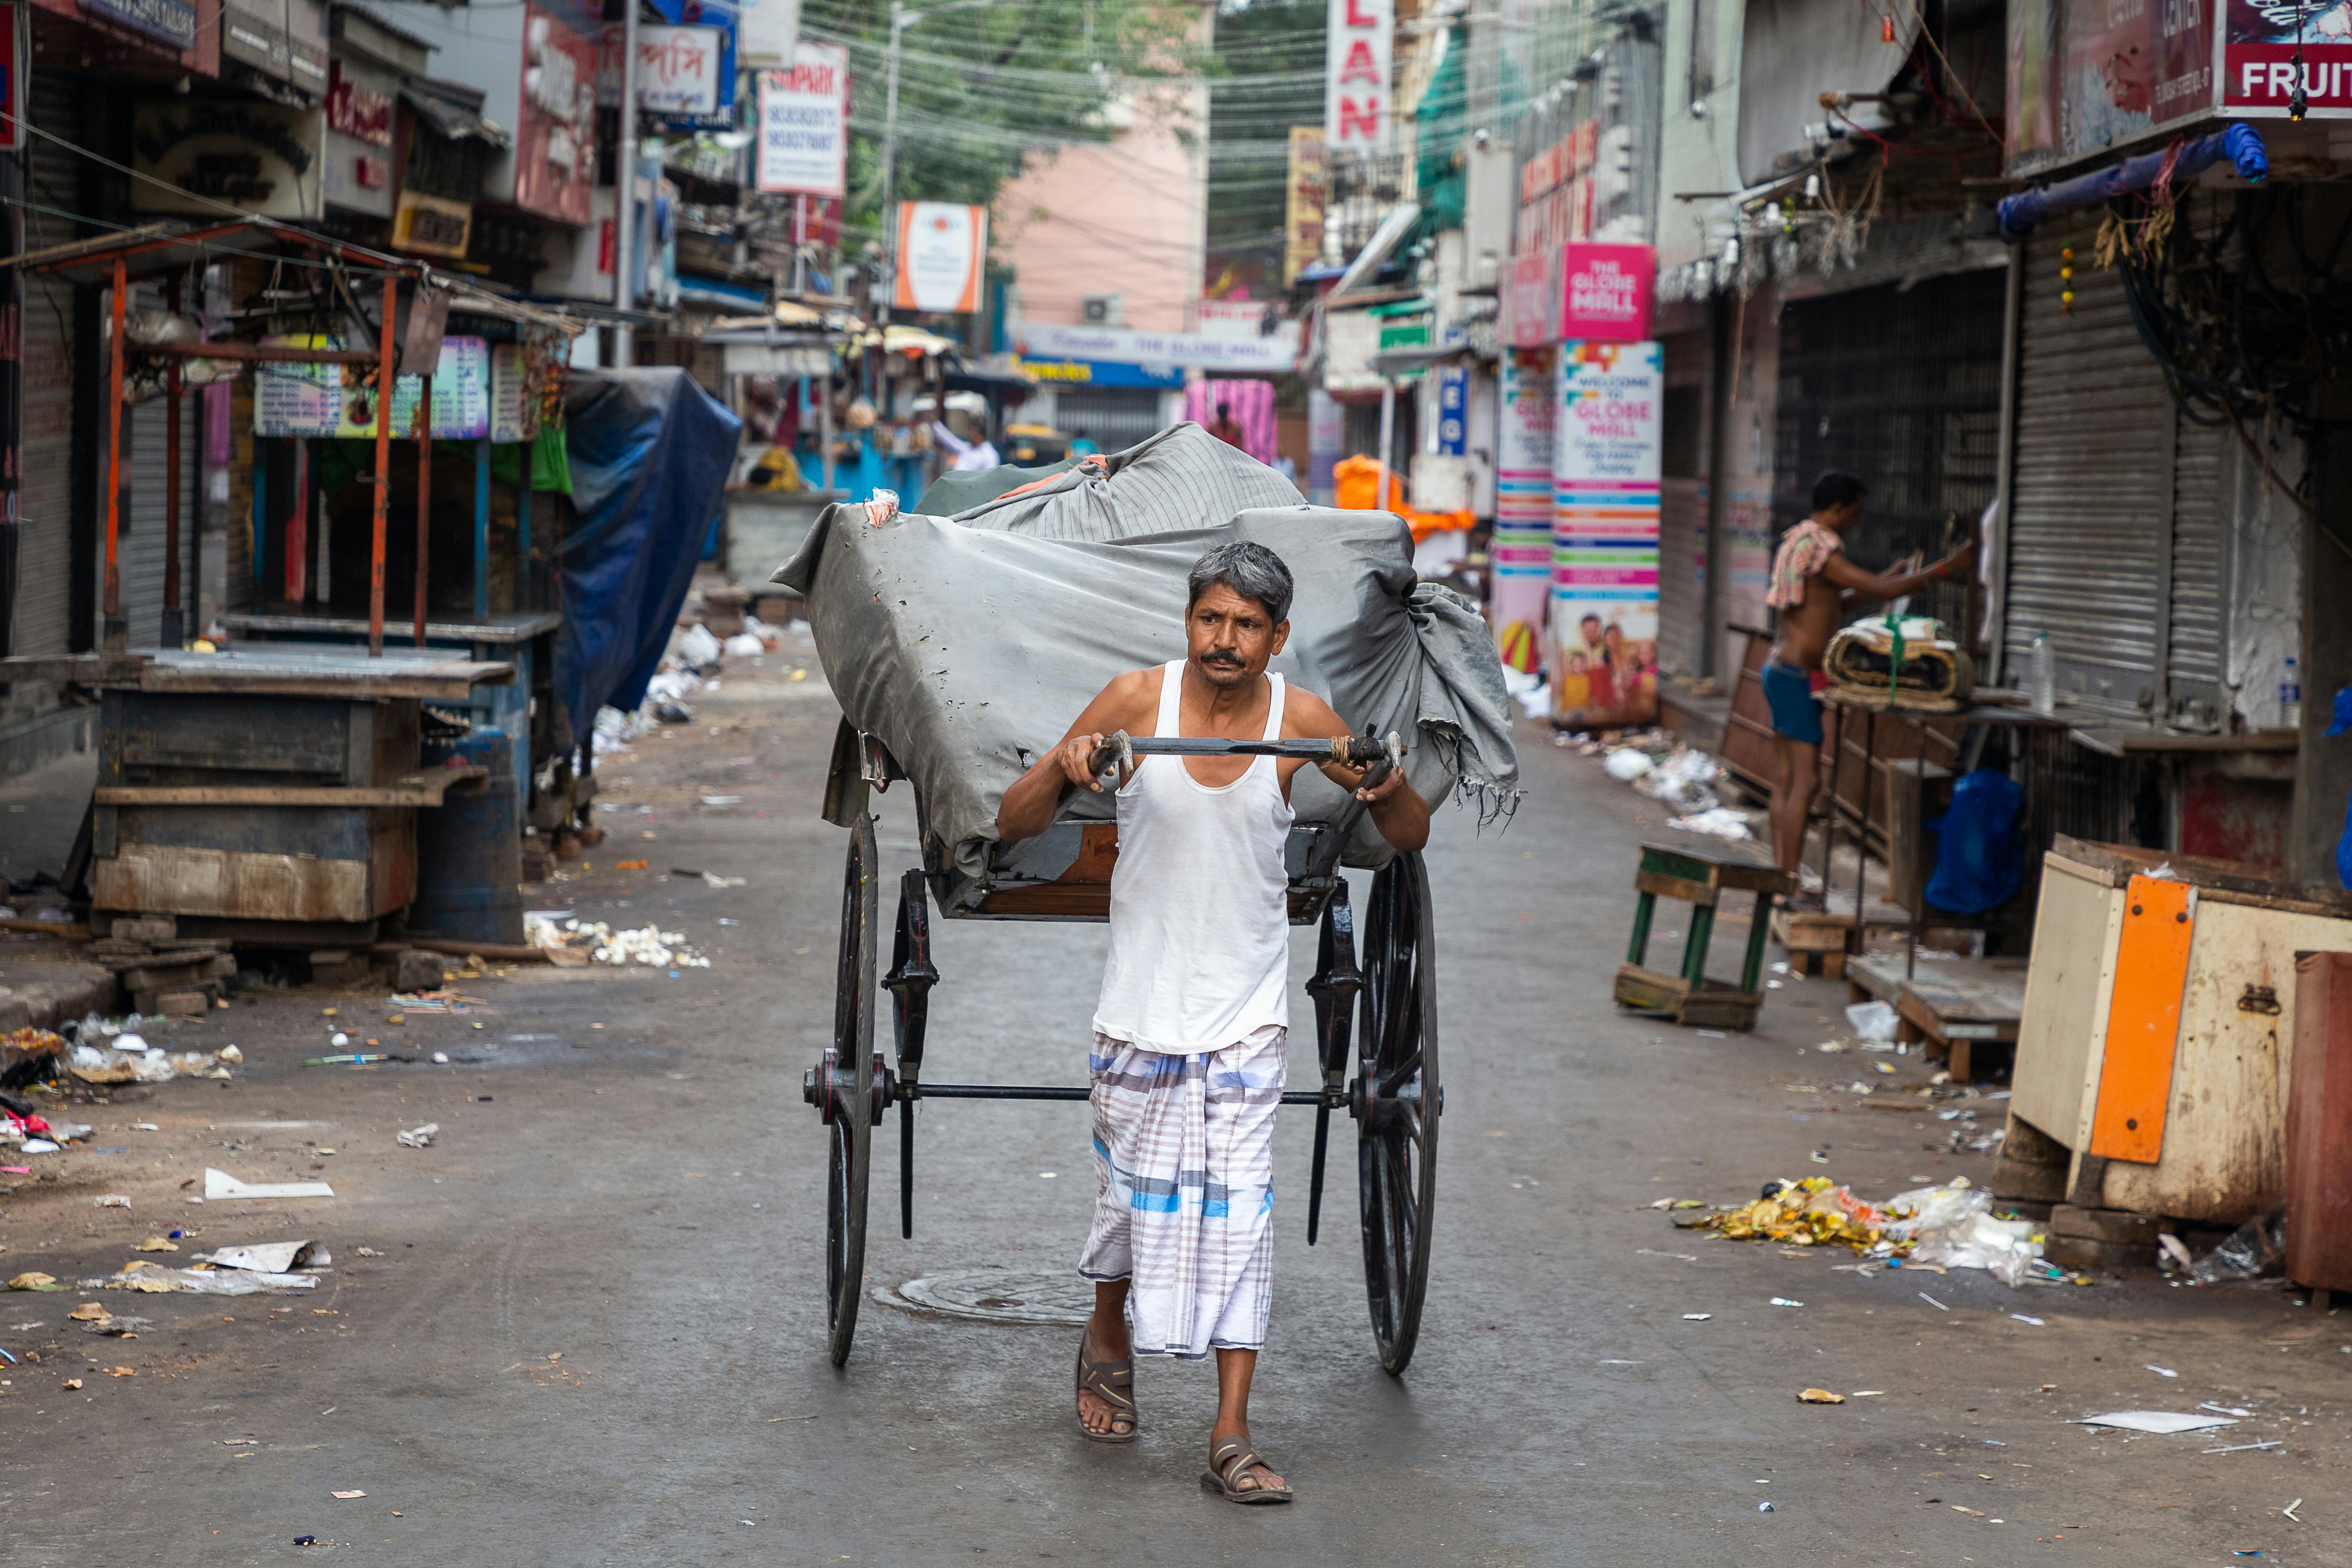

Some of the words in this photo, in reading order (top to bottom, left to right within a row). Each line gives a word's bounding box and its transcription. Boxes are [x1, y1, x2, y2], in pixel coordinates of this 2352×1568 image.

[1591, 261, 1619, 274] THE
[1571, 273, 1636, 291] GLOBE
[1571, 291, 1637, 313] MALL
[1578, 376, 1651, 388] WELCOME
[1575, 402, 1651, 421] GLOBE
[1588, 421, 1638, 438] MALL
